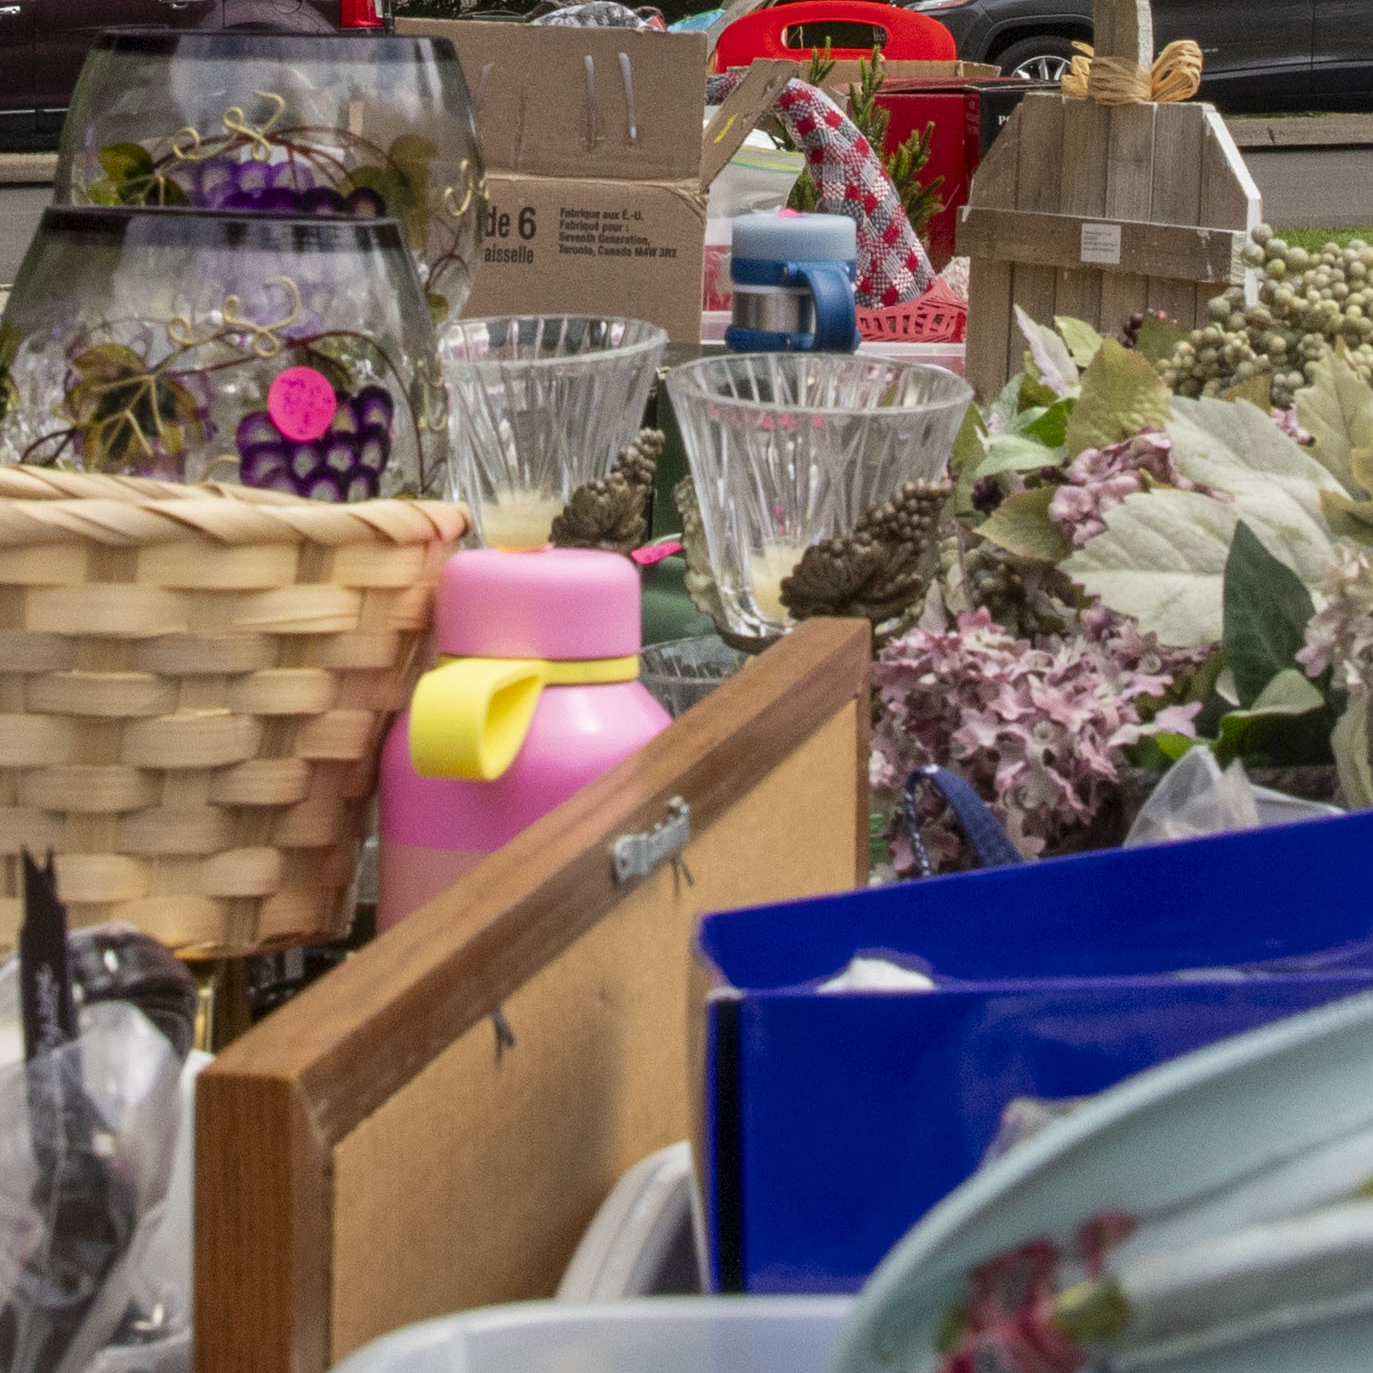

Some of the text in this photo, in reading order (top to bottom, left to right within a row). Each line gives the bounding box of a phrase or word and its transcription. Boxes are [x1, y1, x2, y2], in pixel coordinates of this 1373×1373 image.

[603, 210, 619, 220] aux
[485, 206, 538, 240] de 6
[602, 223, 624, 234] pour
[558, 233, 651, 246] Seventh Generation,
[558, 244, 678, 258] Toronto, Canada M4W 3R2
